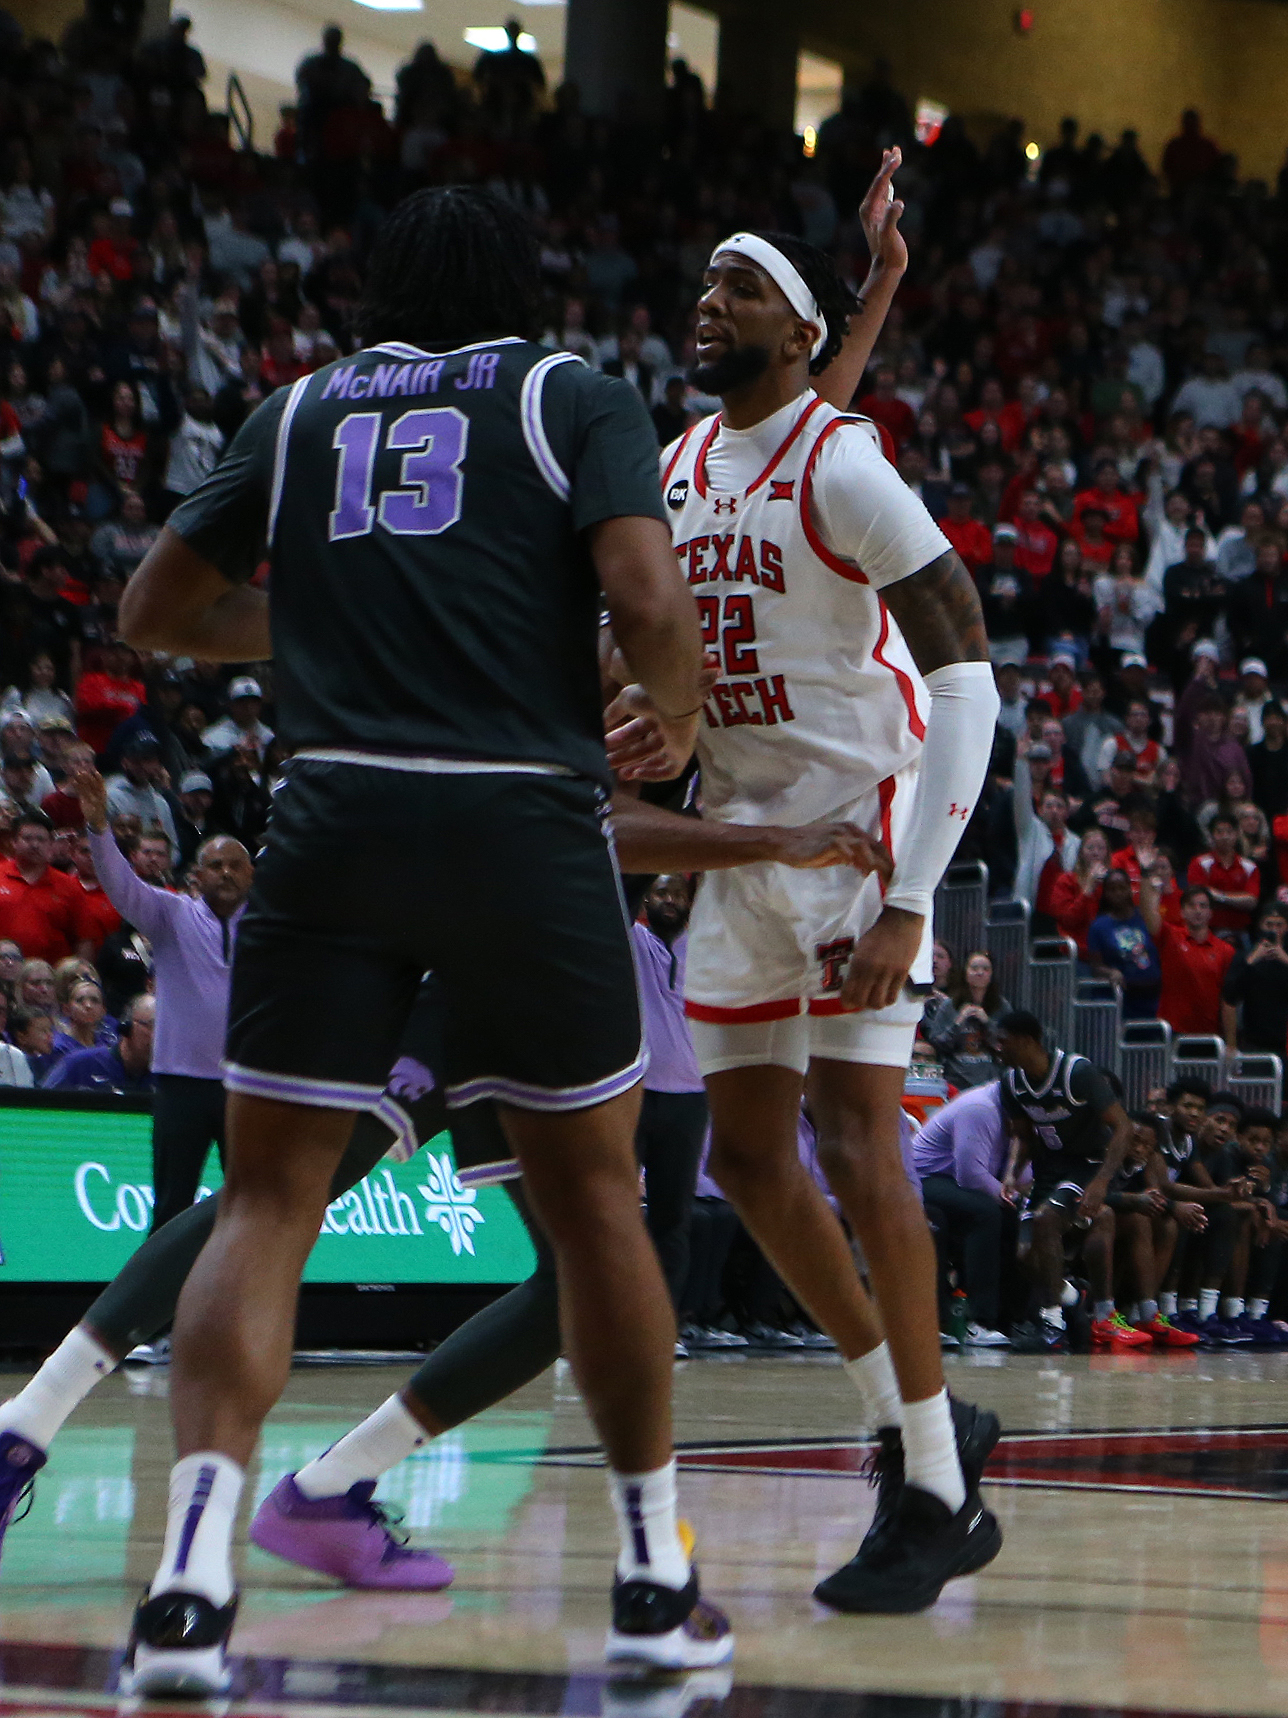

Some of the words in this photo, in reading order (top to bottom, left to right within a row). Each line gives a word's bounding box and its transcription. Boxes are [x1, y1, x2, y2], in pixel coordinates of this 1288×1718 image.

[319, 359, 447, 400] McNAIR
[453, 353, 500, 390] JR
[328, 405, 470, 542] 13
[669, 486, 688, 502] BK
[319, 1168, 425, 1236] ealth
